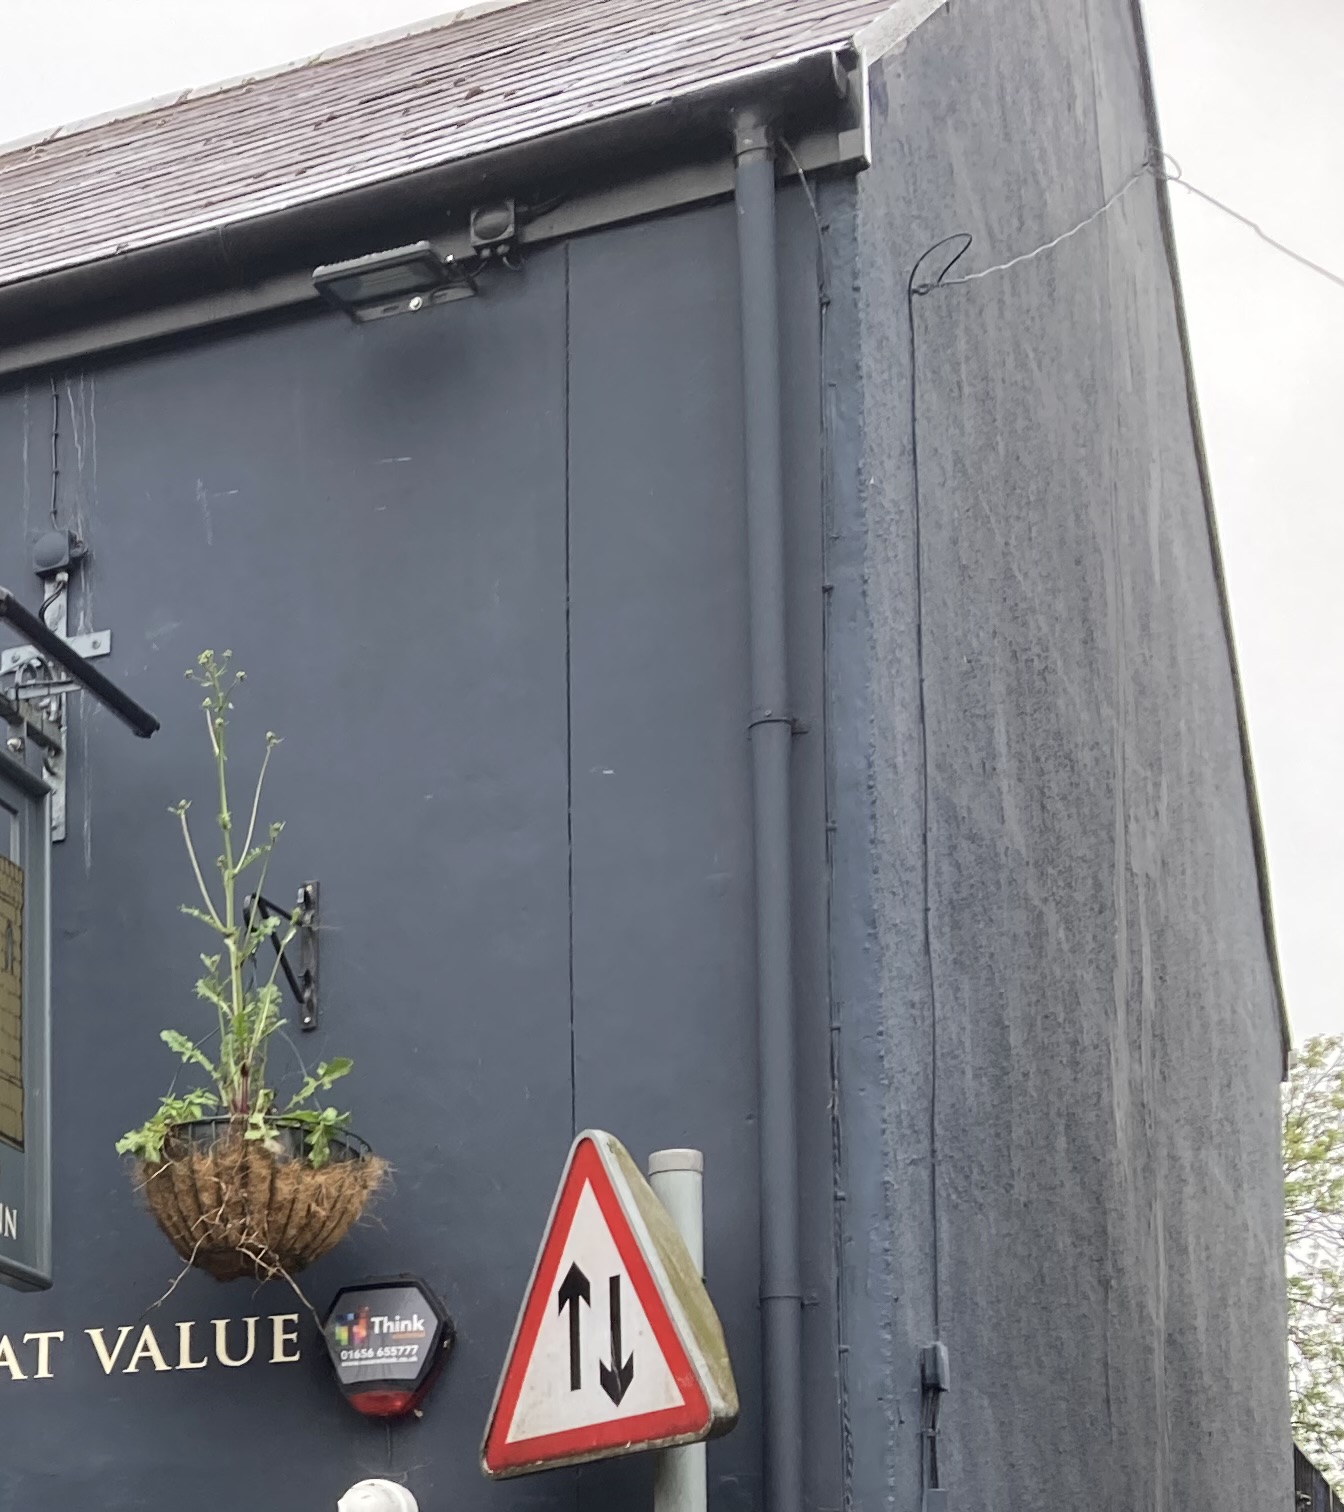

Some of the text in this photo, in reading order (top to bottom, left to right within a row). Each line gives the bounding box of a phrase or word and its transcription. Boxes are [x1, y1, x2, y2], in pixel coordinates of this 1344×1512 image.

[370, 1314, 424, 1334] Think
[84, 1313, 301, 1374] VALUE
[340, 1345, 419, 1360] 01656 655777
